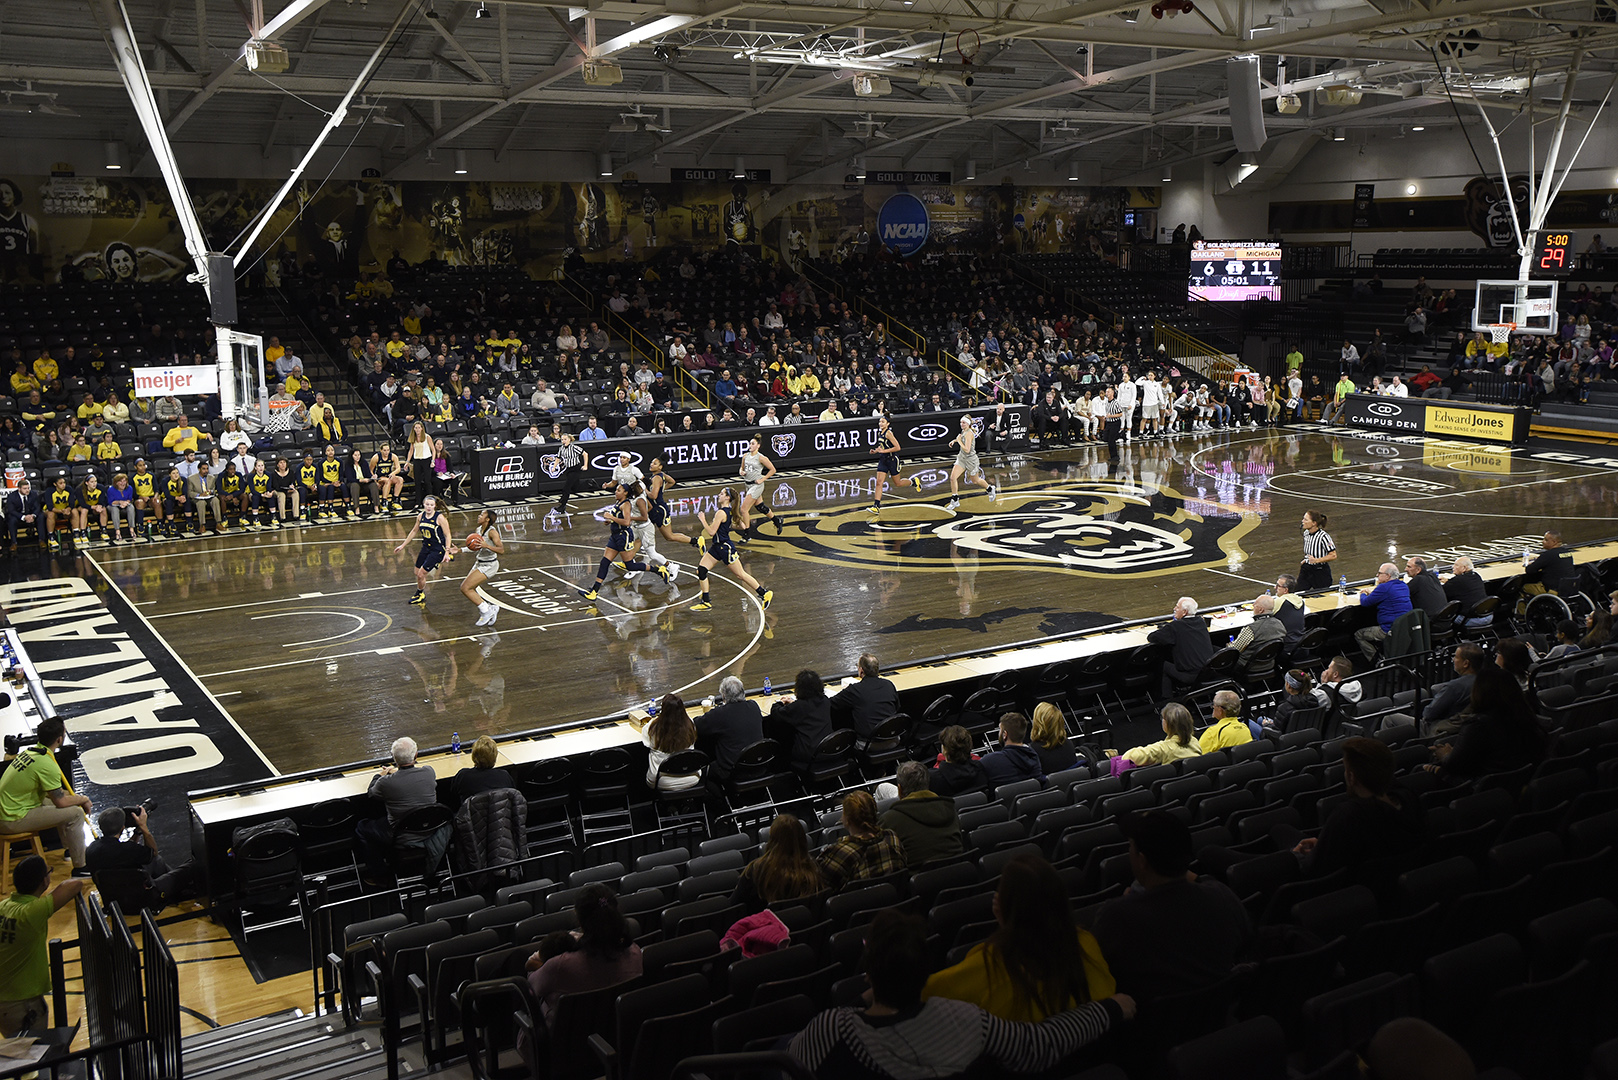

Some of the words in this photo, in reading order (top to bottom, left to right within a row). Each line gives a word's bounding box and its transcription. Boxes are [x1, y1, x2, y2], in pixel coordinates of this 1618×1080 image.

[366, 169, 377, 177] E3
[685, 170, 716, 181] GOLD
[877, 173, 904, 183] GOLD
[914, 173, 940, 183] ZONE
[883, 223, 926, 239] NCAA
[4, 235, 17, 251] 3
[1546, 234, 1569, 246] 5:00
[1540, 248, 1565, 269] 29
[1203, 262, 1215, 276] 6
[1232, 265, 1238, 274] 1
[1250, 261, 1273, 276] 11
[1221, 276, 1249, 285] 05:01
[136, 370, 193, 391] meijer
[1378, 405, 1391, 414] CD
[1352, 415, 1393, 427] CAMPUS
[1396, 419, 1417, 429] DEN
[1434, 410, 1471, 425] Edward
[1472, 414, 1504, 428] Jones
[920, 428, 938, 438] CD
[1477, 428, 1503, 436] INVESTING
[814, 429, 861, 451] GEAR
[663, 443, 718, 465] TEAM
[725, 439, 751, 459] UP
[326, 464, 338, 473] M
[303, 470, 314, 479] M
[483, 474, 504, 483] FARM
[504, 472, 535, 480] BUREAU
[137, 478, 150, 487] M
[255, 479, 266, 487] M
[489, 480, 530, 491] INSURANCE
[55, 496, 67, 504] M
[487, 580, 573, 615] HORIZON
[0, 576, 225, 785] OAKLAND
